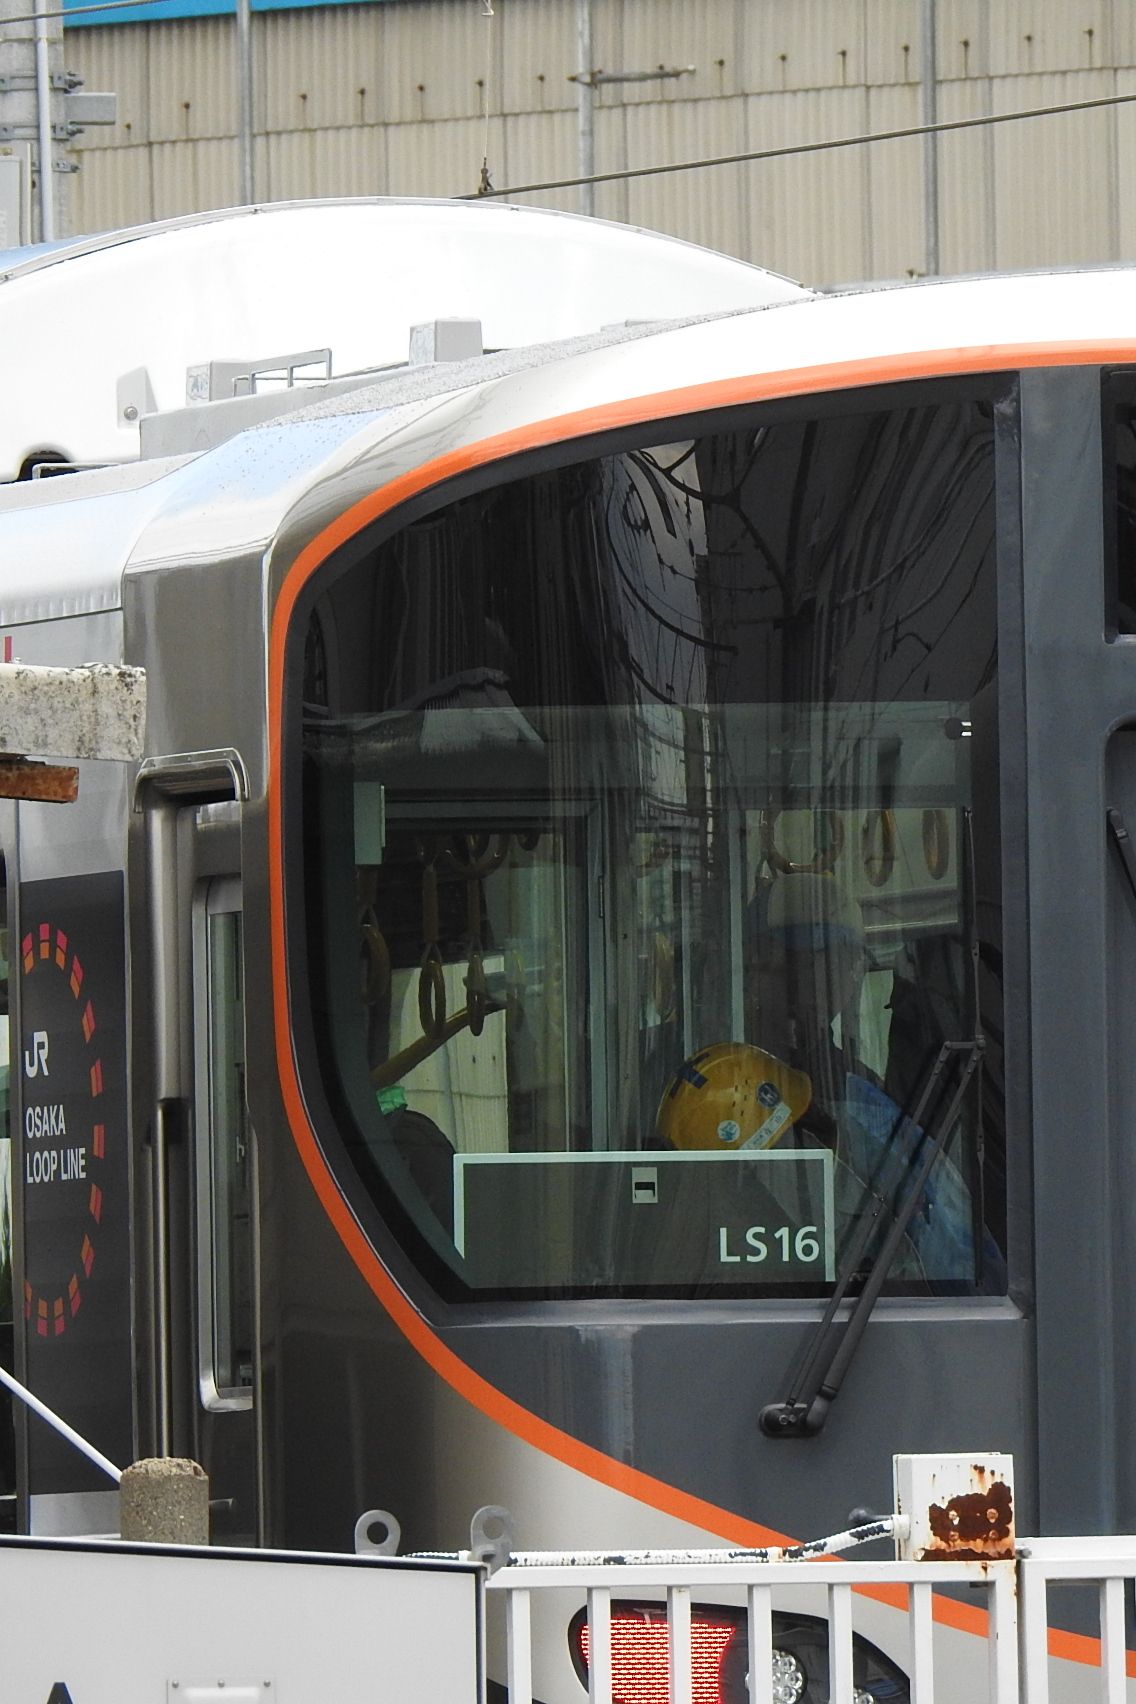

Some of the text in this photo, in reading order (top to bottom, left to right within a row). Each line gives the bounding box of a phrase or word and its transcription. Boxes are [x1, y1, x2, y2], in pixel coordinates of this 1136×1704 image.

[24, 1031, 49, 1078] JR
[25, 1104, 66, 1139] OSAKA
[26, 1147, 87, 1184] LOOP LINE
[719, 1226, 820, 1263] LS16
